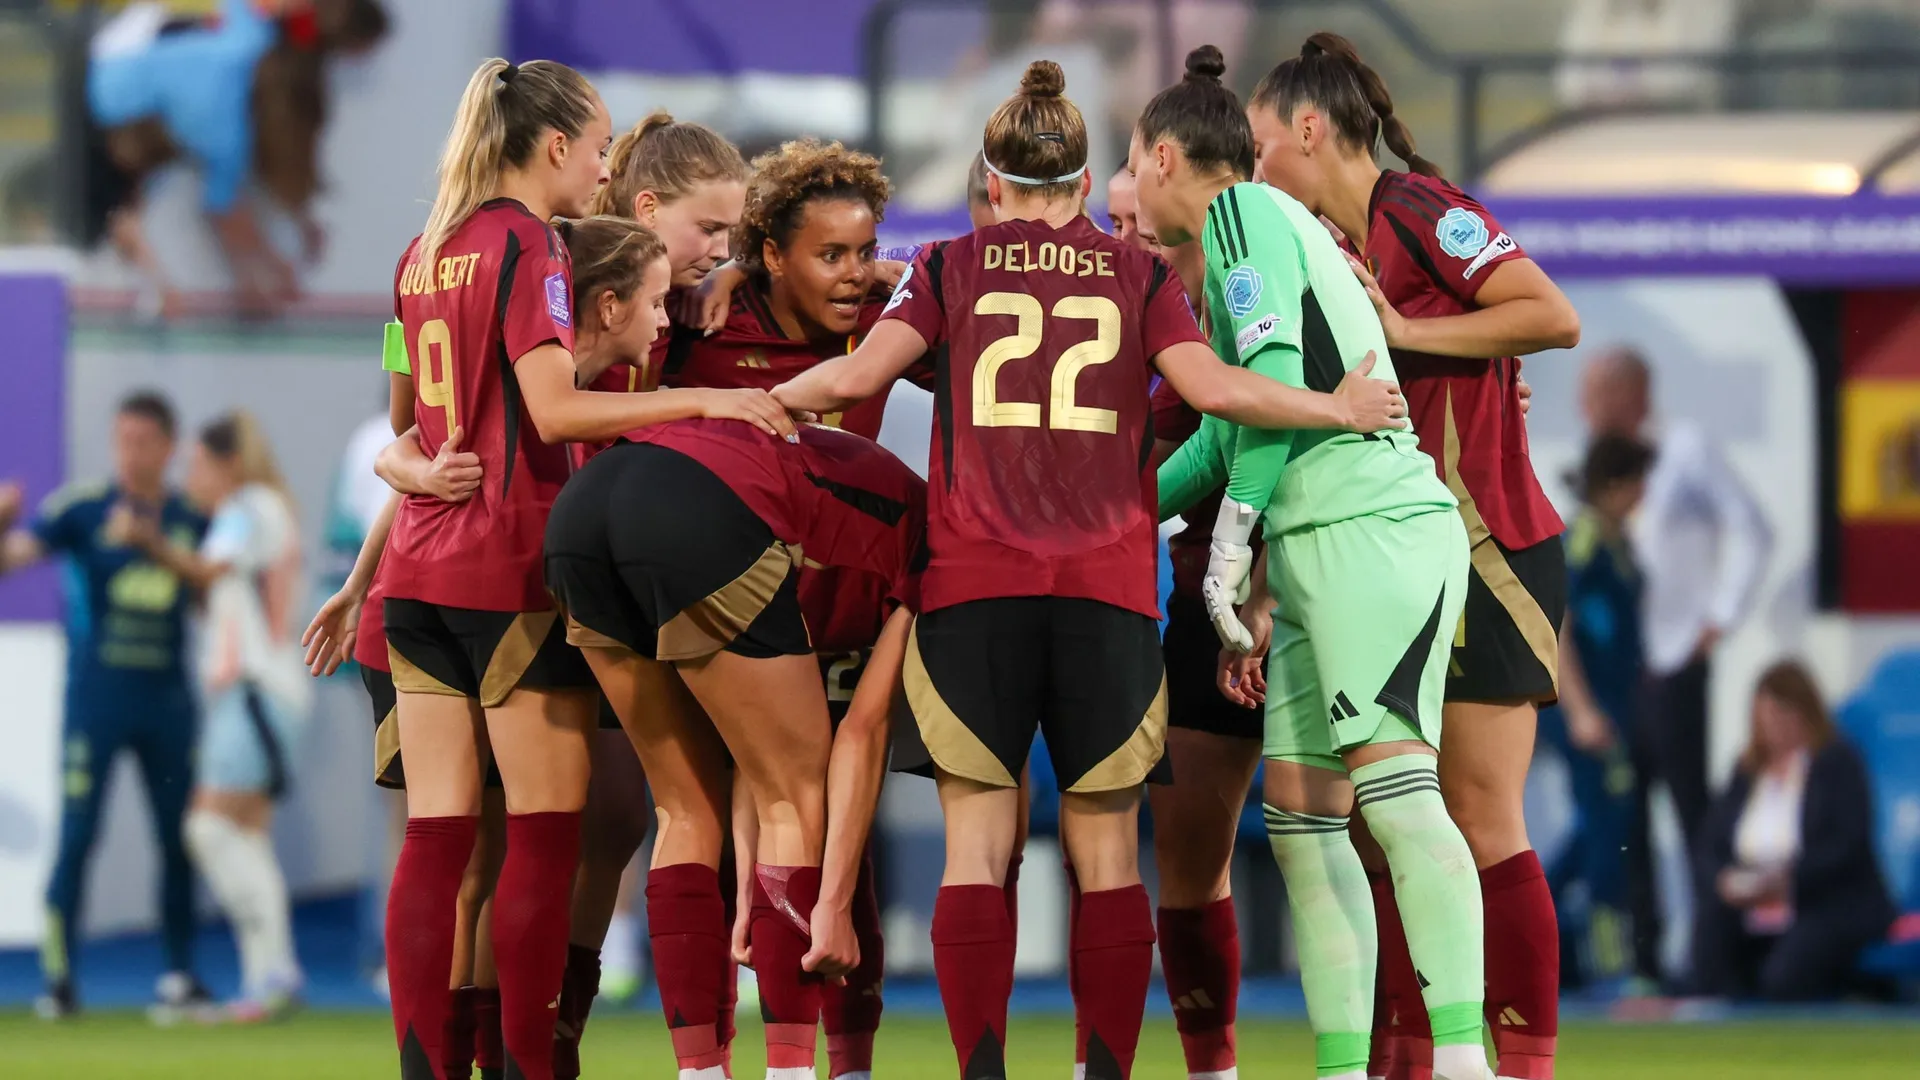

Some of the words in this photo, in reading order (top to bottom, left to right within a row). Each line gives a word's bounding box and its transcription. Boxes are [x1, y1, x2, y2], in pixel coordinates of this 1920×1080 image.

[400, 252, 481, 297] WULAERT
[984, 240, 1115, 277] DELOOSE
[417, 318, 456, 437] 9
[973, 291, 1121, 434] 22
